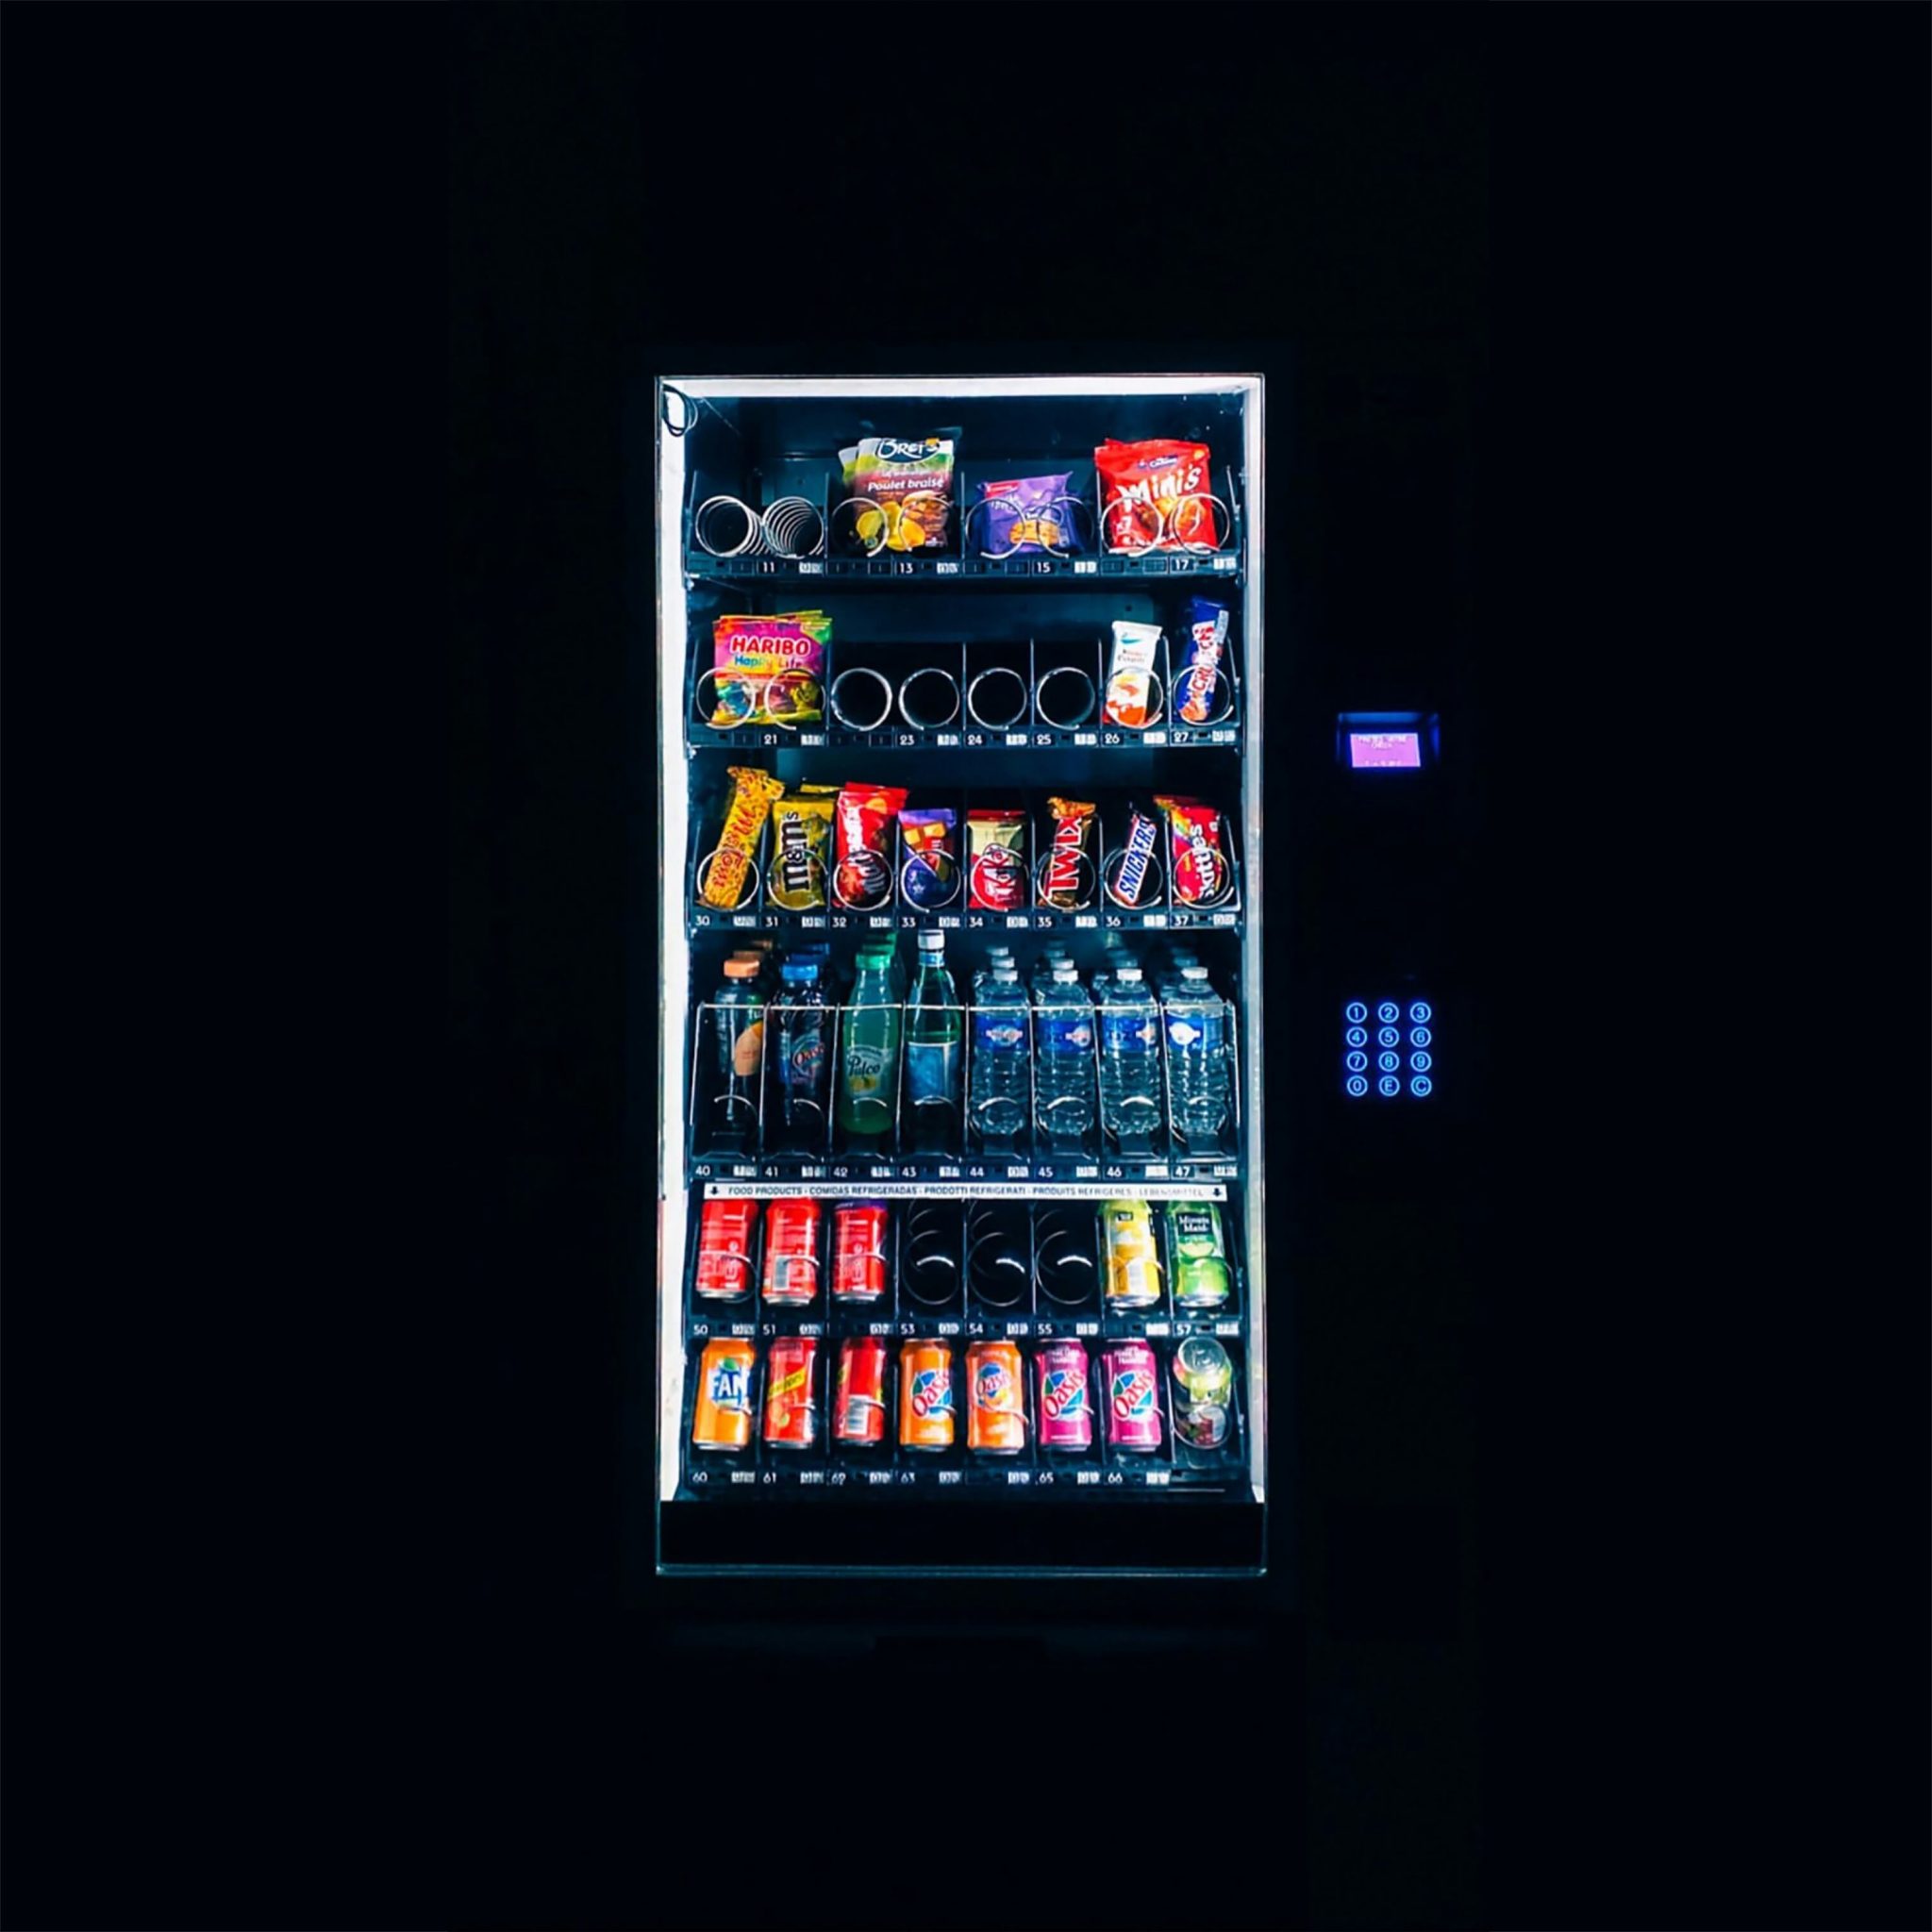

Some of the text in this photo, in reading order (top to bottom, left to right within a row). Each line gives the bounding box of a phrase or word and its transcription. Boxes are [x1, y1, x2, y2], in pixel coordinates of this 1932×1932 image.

[868, 479, 906, 491] Poulet
[764, 562, 774, 572] 11
[901, 563, 912, 574] 13
[1038, 562, 1050, 573] 15
[1174, 558, 1189, 570] 17
[731, 637, 809, 656] HARIBO
[764, 735, 776, 744] 21
[900, 735, 914, 745] 23
[968, 735, 982, 745] 24
[1038, 734, 1051, 744] 25
[1106, 733, 1120, 743] 26
[1174, 732, 1189, 742] 27
[1119, 817, 1157, 899] SNICKERS
[695, 916, 709, 926] 30
[767, 917, 777, 926] 31
[833, 917, 846, 927] 32
[903, 917, 915, 927] 33
[970, 917, 983, 927] 34
[1039, 917, 1052, 927] 35
[1107, 916, 1120, 926] 36
[695, 1166, 709, 1175] 40
[766, 1167, 777, 1176] 41
[834, 1168, 847, 1176] 42
[903, 1167, 916, 1176] 43
[971, 1168, 984, 1176] 44
[1039, 1167, 1053, 1177] 45
[1108, 1167, 1122, 1176] 46
[728, 1186, 754, 1196] FOOD
[755, 1186, 803, 1196] PRODUCTS
[808, 1186, 850, 1196] COMIDAS
[851, 1186, 917, 1196] REFRIGERADAS
[924, 1186, 968, 1196] PRODOTTI
[969, 1186, 1026, 1197] REFRIGERATI
[1032, 1186, 1076, 1197] PRODUITS
[694, 1324, 708, 1335] 50
[763, 1324, 775, 1335] 51
[901, 1324, 914, 1334] 53
[970, 1324, 983, 1334] 54
[1039, 1324, 1052, 1334] 55
[1044, 1371, 1084, 1418] Oasis
[1114, 1371, 1154, 1418] Oasis
[692, 1472, 708, 1482] 60
[763, 1473, 775, 1483] 61
[1040, 1473, 1053, 1483] 65
[1108, 1473, 1123, 1483] 66
